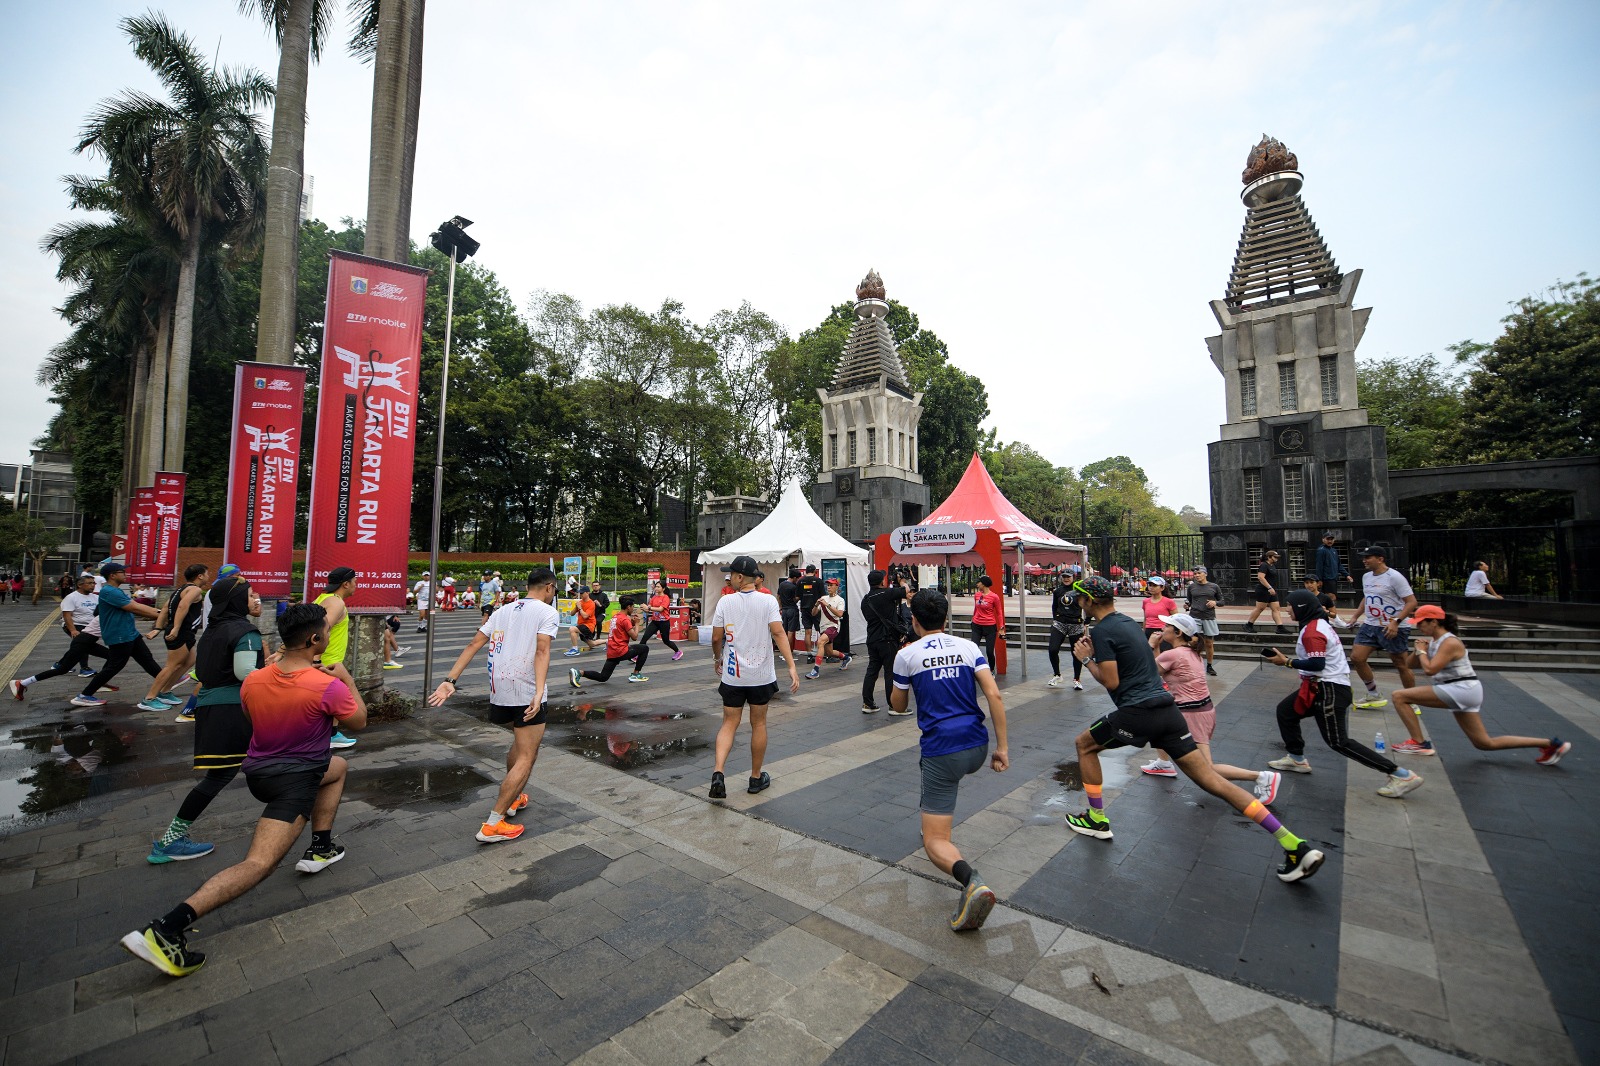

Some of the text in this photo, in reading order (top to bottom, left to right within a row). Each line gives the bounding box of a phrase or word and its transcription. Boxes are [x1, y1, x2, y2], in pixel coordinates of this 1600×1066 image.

[346, 313, 407, 328] BTN mobile
[393, 401, 410, 438] BTN
[282, 458, 294, 483] BTN
[337, 404, 354, 539] JAKARTA SUCCESS FOR INDONESIA
[356, 395, 385, 544] JAKARTA RUN
[258, 455, 278, 554] JAKARTA RUN
[115, 541, 124, 550] 6
[158, 517, 170, 565] JAKARTA RUN
[914, 533, 948, 541] JAKARTA
[922, 654, 964, 668] CERITA
[932, 667, 960, 680] LARI
